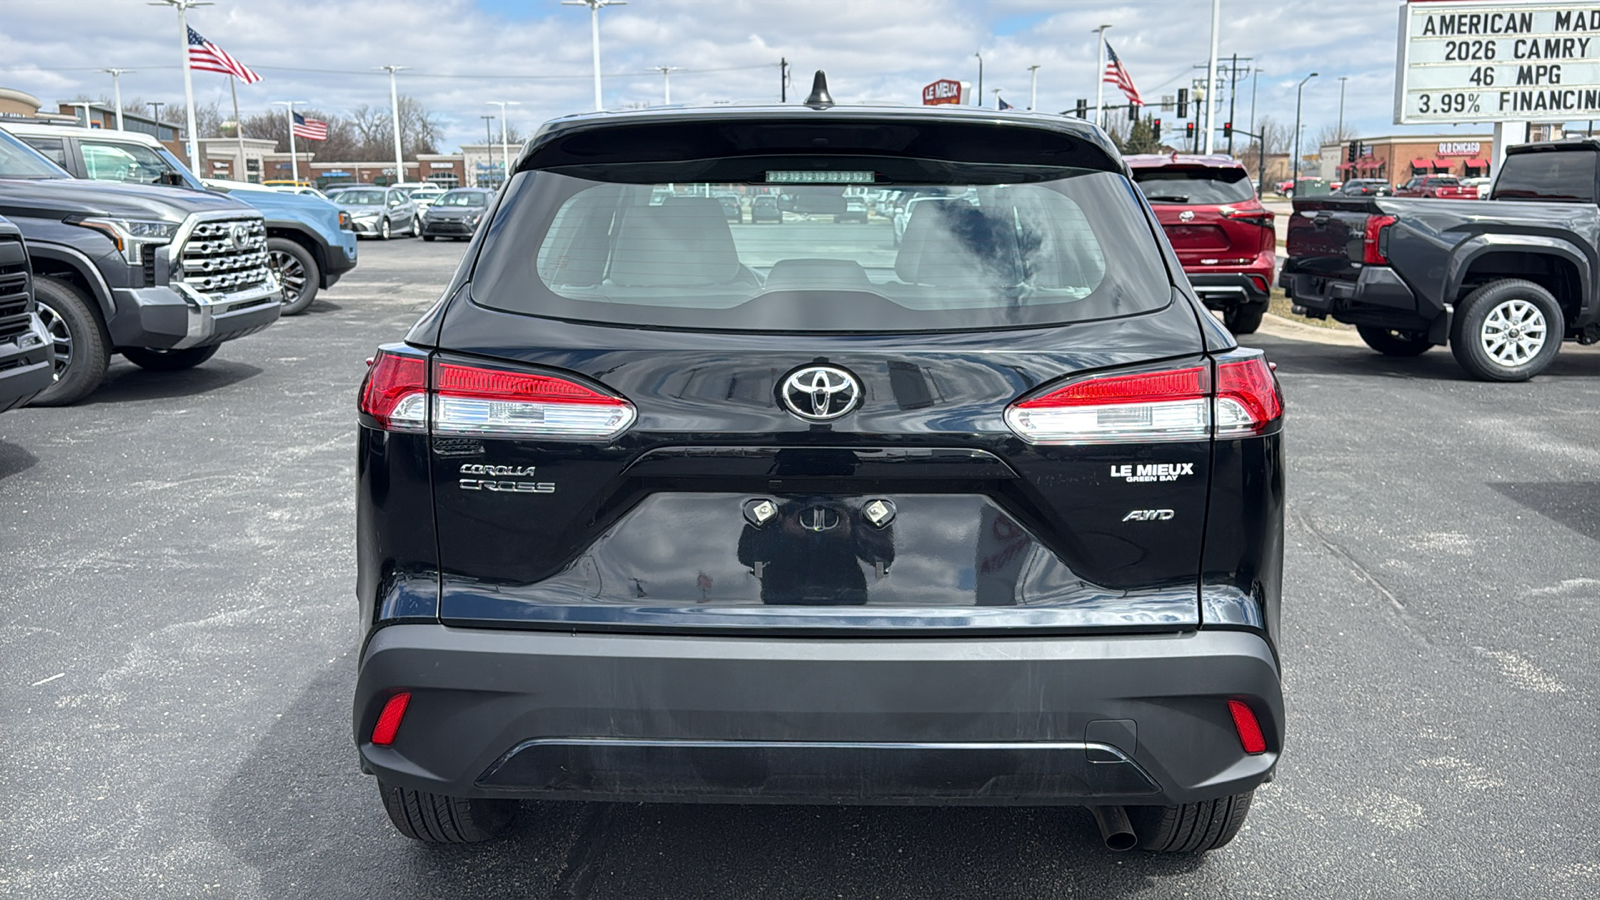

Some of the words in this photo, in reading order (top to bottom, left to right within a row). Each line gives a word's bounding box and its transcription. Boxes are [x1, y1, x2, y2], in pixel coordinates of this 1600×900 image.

[1422, 13, 1533, 35] AMERICAN
[1445, 40, 1496, 61] 2026
[1513, 38, 1591, 59] CAMRY
[1469, 66, 1495, 87] 46
[1516, 65, 1561, 85] MPG
[925, 86, 934, 100] LE
[1418, 93, 1481, 114] 3.99%
[1499, 90, 1600, 111] FINANCIN
[459, 464, 536, 476] COROLLA
[1110, 465, 1133, 477] LE
[1137, 463, 1194, 476] MIEUX
[459, 478, 556, 493] CROSS
[1126, 475, 1157, 483] GREEN
[1122, 509, 1175, 522] AWD
